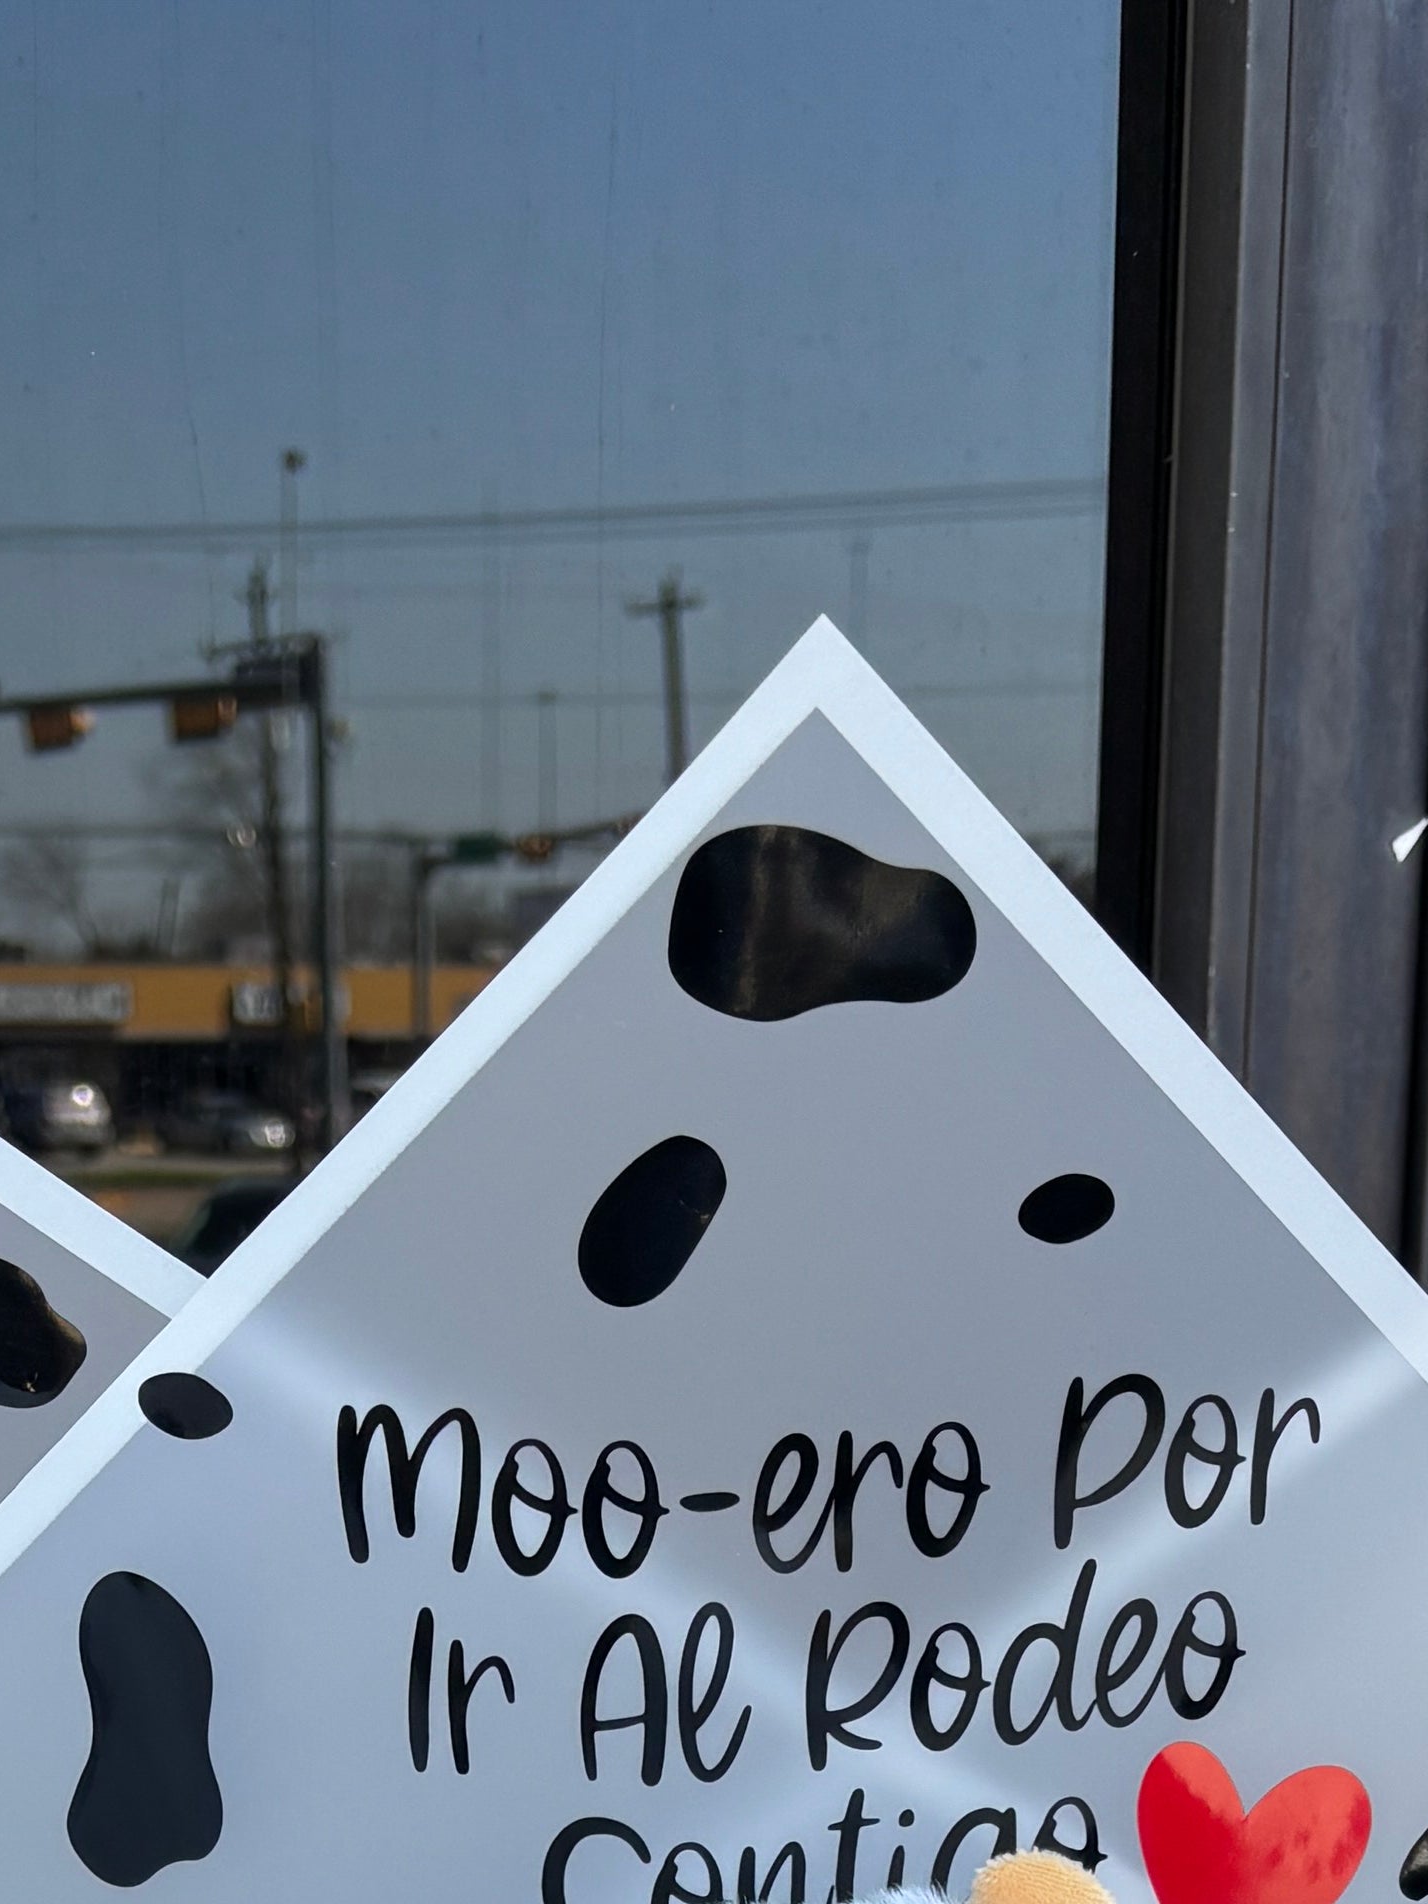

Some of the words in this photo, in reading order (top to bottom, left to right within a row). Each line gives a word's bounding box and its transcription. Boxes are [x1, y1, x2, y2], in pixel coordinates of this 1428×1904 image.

[336, 1403, 991, 1579] Moo-ero
[1053, 1373, 1321, 1550] Por
[407, 1606, 515, 1775] Ir
[580, 1601, 752, 1787] Al
[805, 1558, 1247, 1772] Rodeo
